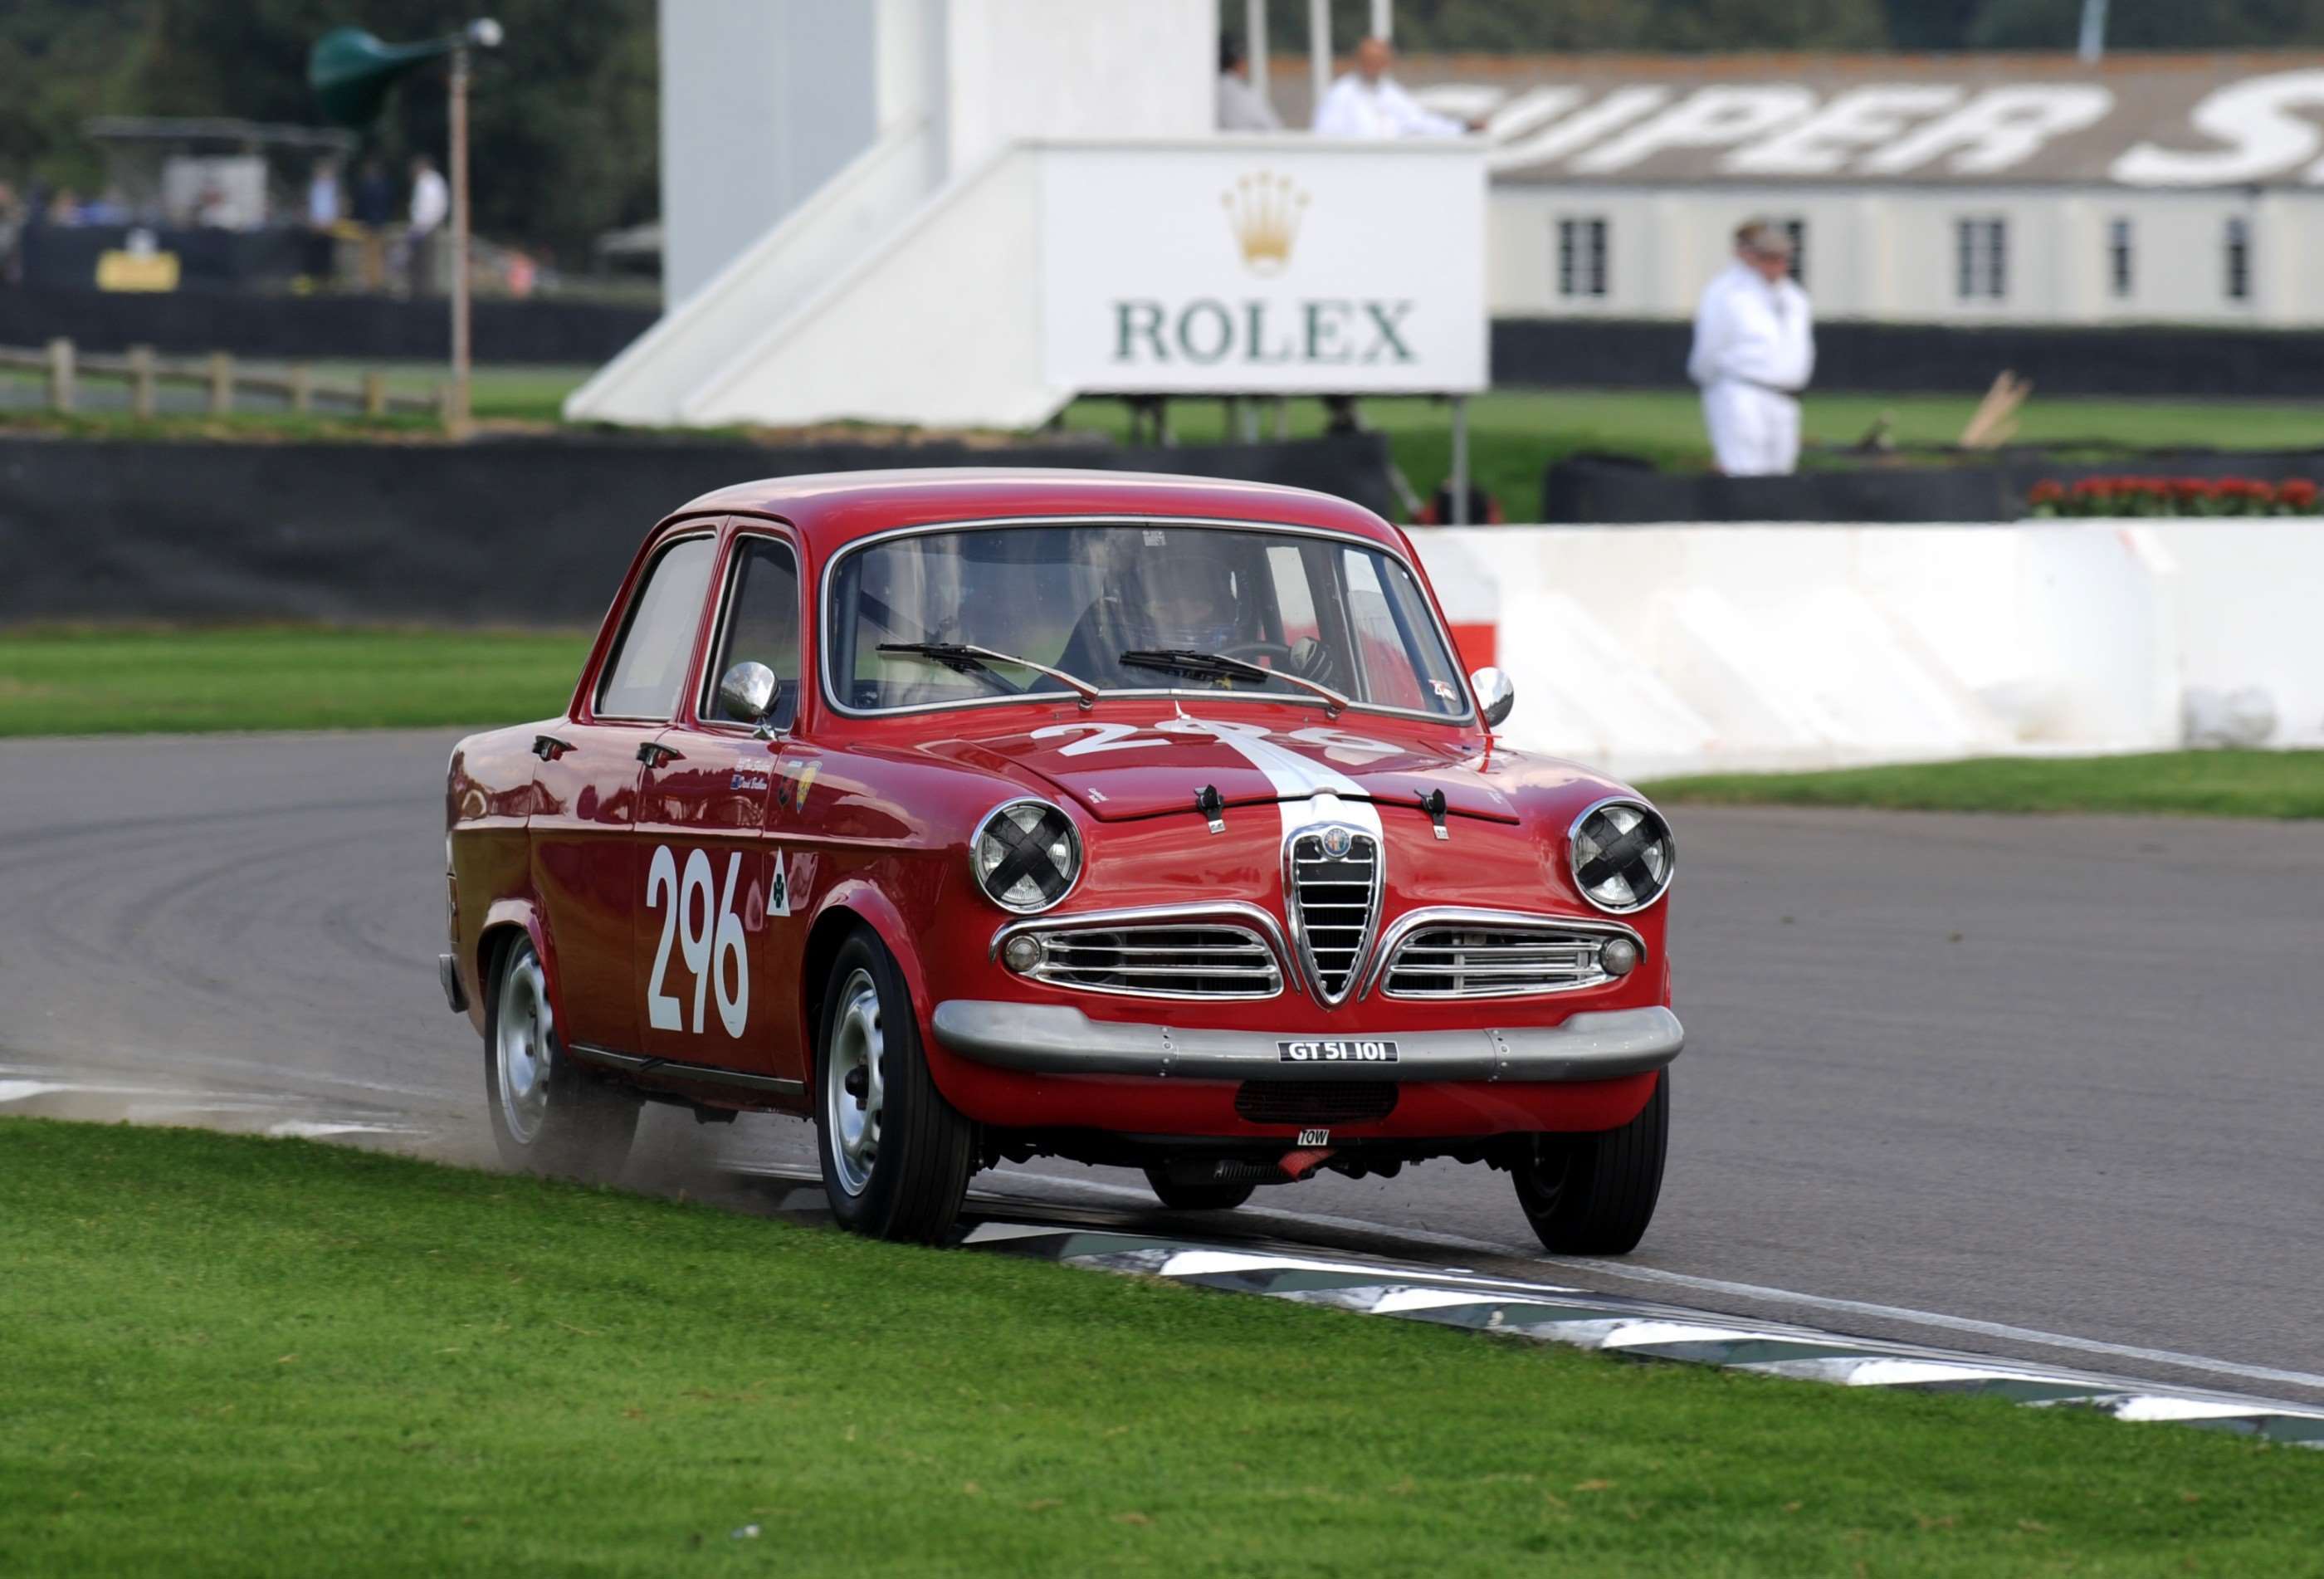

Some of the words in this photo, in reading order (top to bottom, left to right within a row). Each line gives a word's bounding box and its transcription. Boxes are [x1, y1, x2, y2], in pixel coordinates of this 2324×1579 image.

[2111, 68, 2324, 183] S
[1111, 297, 1418, 364] ROLEX
[646, 844, 749, 1039] 296
[1288, 1042, 1320, 1060] GT
[1324, 1042, 1347, 1060] 51
[1300, 1130, 1328, 1144] TOW
